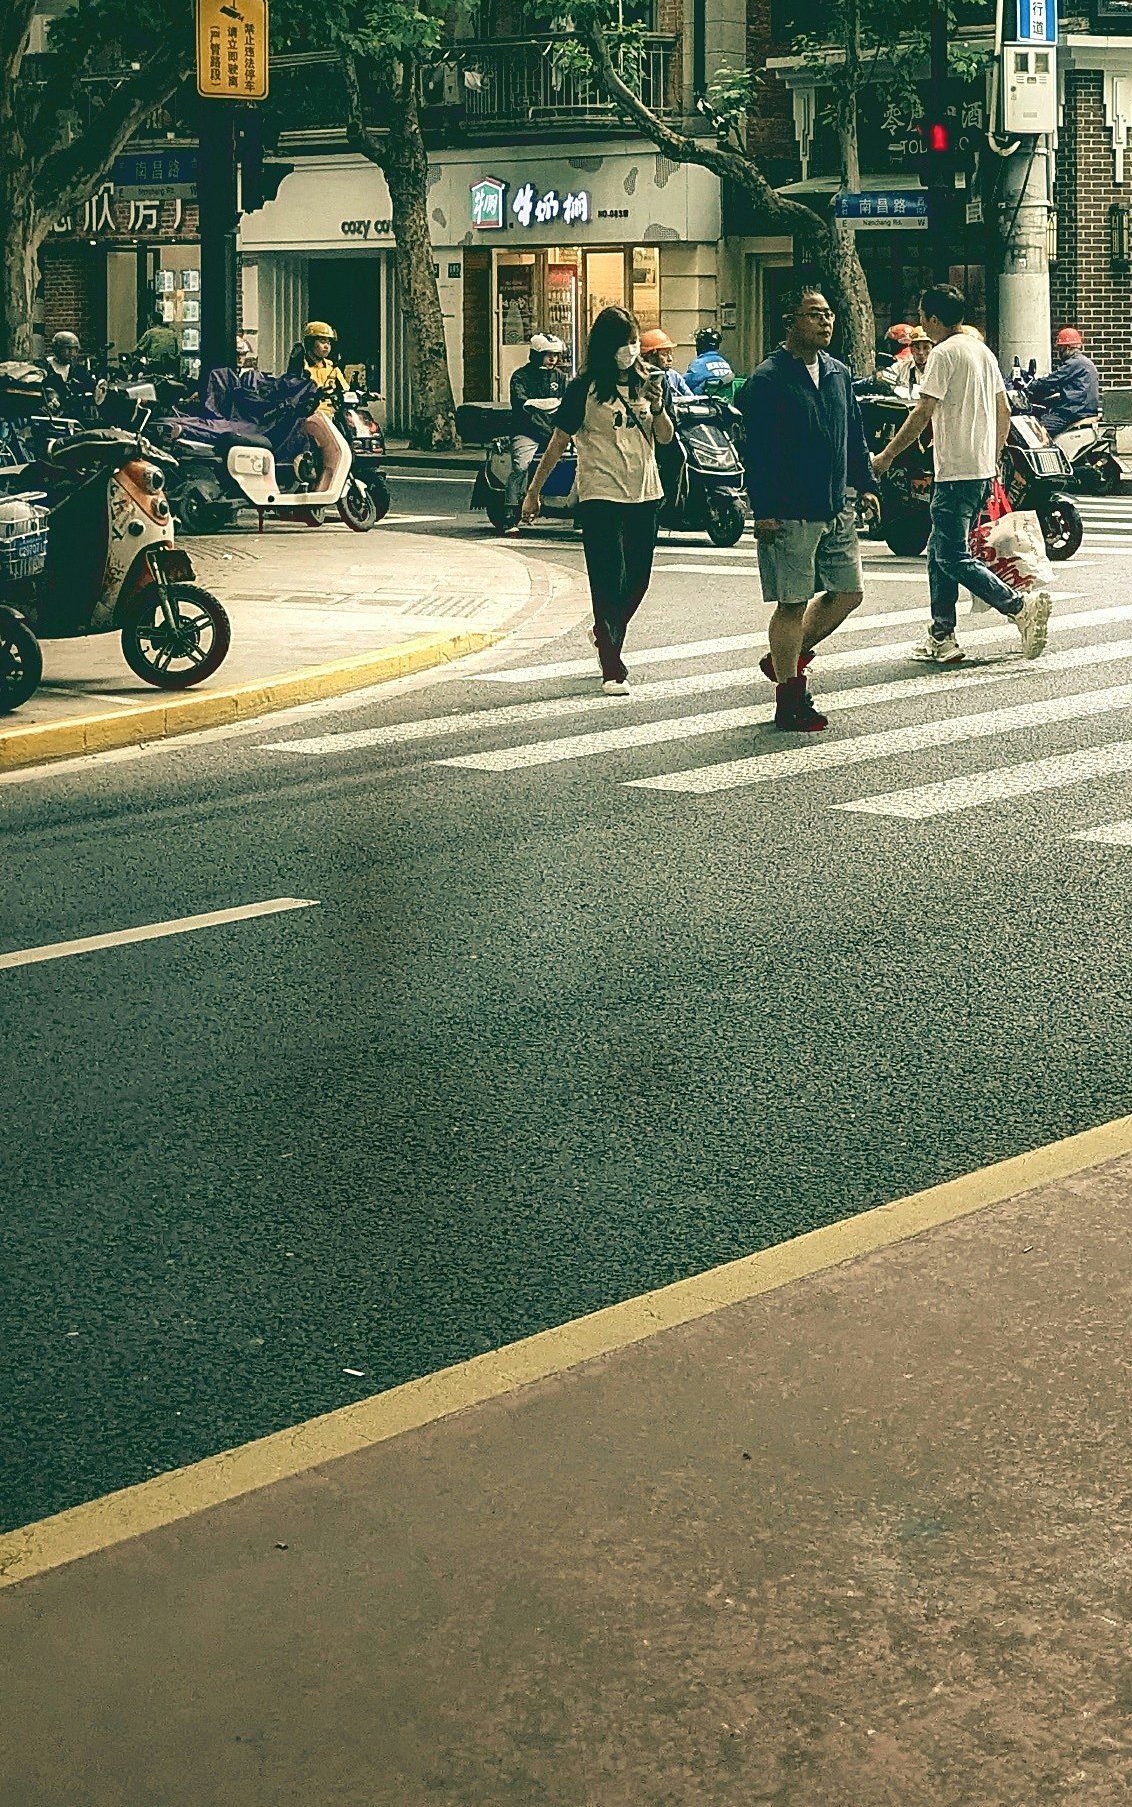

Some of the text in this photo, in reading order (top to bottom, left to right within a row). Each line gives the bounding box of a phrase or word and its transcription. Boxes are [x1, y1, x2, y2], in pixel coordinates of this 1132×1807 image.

[227, 26, 239, 88] 请立即驶离
[244, 23, 255, 92] 禁止违法停车
[135, 159, 180, 181] 南昌路
[512, 183, 587, 227] 牛奶棚
[859, 198, 906, 215] 南昌路
[340, 219, 371, 239] cozy
[862, 219, 892, 227] Nanchang
